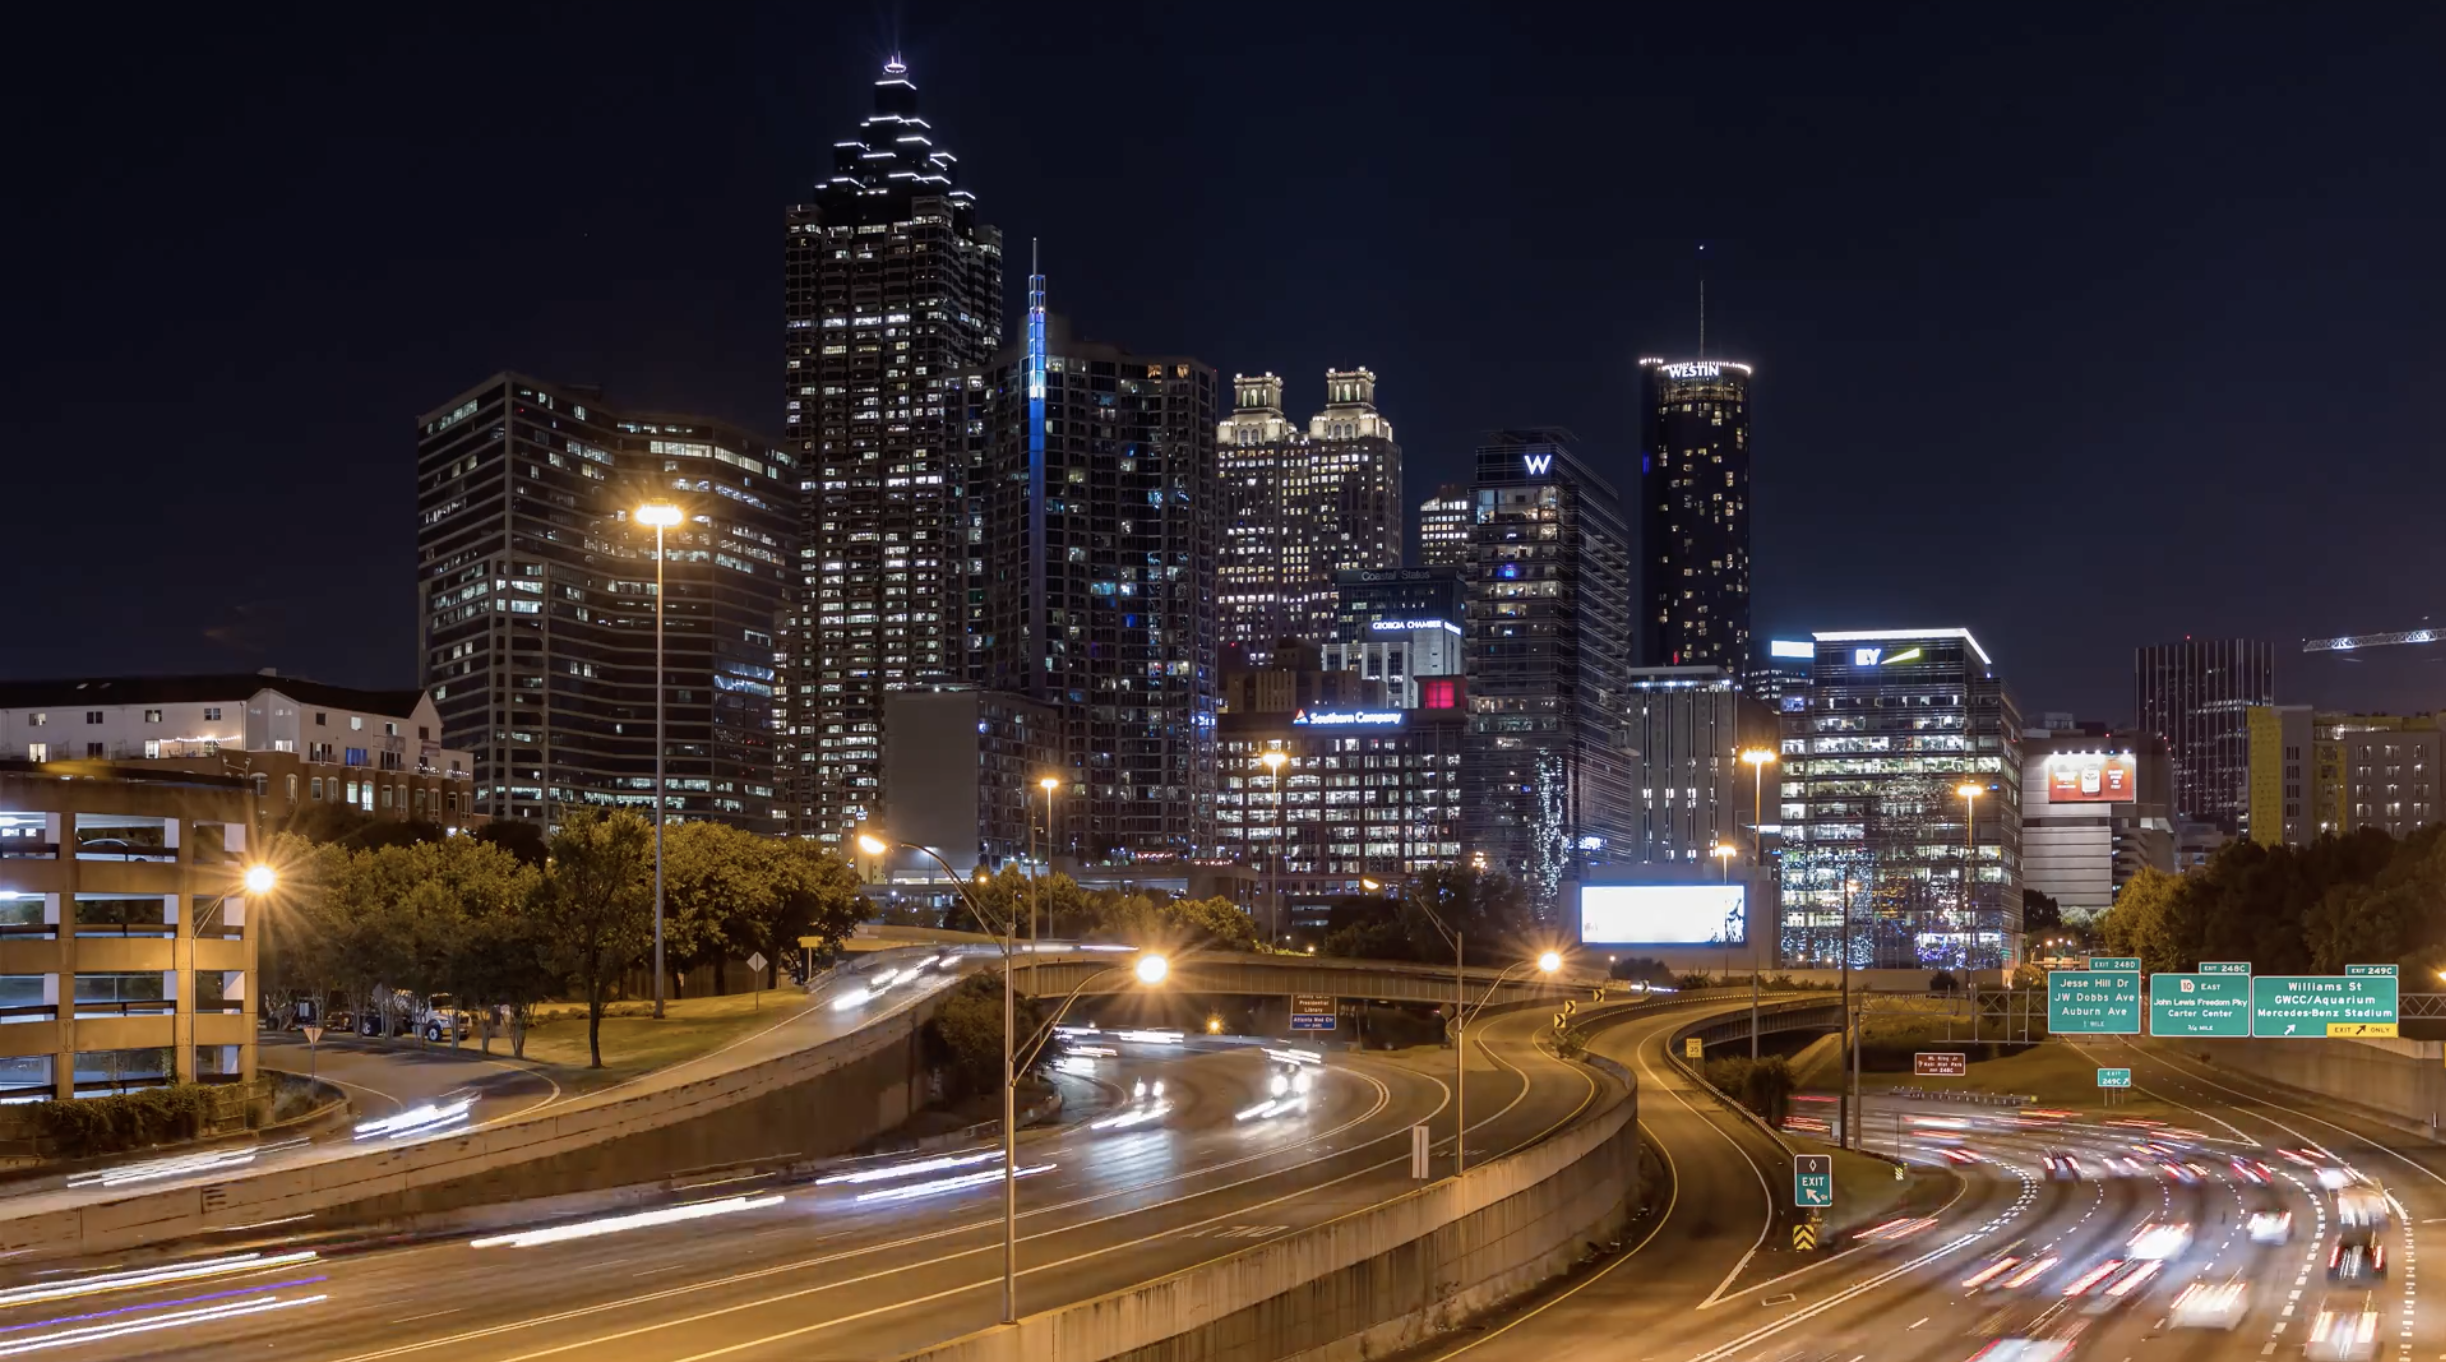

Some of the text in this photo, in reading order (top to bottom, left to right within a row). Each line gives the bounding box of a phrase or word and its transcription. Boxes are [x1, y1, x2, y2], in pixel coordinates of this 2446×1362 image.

[1669, 364, 1720, 378] WESTIN
[1524, 455, 1552, 475] W
[1361, 570, 1430, 581] Coastal States
[1372, 621, 1405, 630] GEORGIA
[1406, 620, 1442, 629] CHAMBER
[1856, 648, 1881, 665] EY
[1310, 711, 1402, 724] Southern Company
[2060, 979, 2129, 988] Jesse Hill Dr
[2183, 982, 2221, 991] 10 EAST
[2288, 982, 2362, 991] Williams St
[2054, 993, 2135, 1002] JW Dobbs Ave
[2154, 998, 2248, 1007] John Lewis Freedom Pky
[2274, 995, 2376, 1006] GWCC/Aquarium
[2061, 1007, 2127, 1015] Auburn Ave
[2257, 1009, 2392, 1017] Mercedes-Benz Stadium
[1802, 1176, 1824, 1187] EXIT
